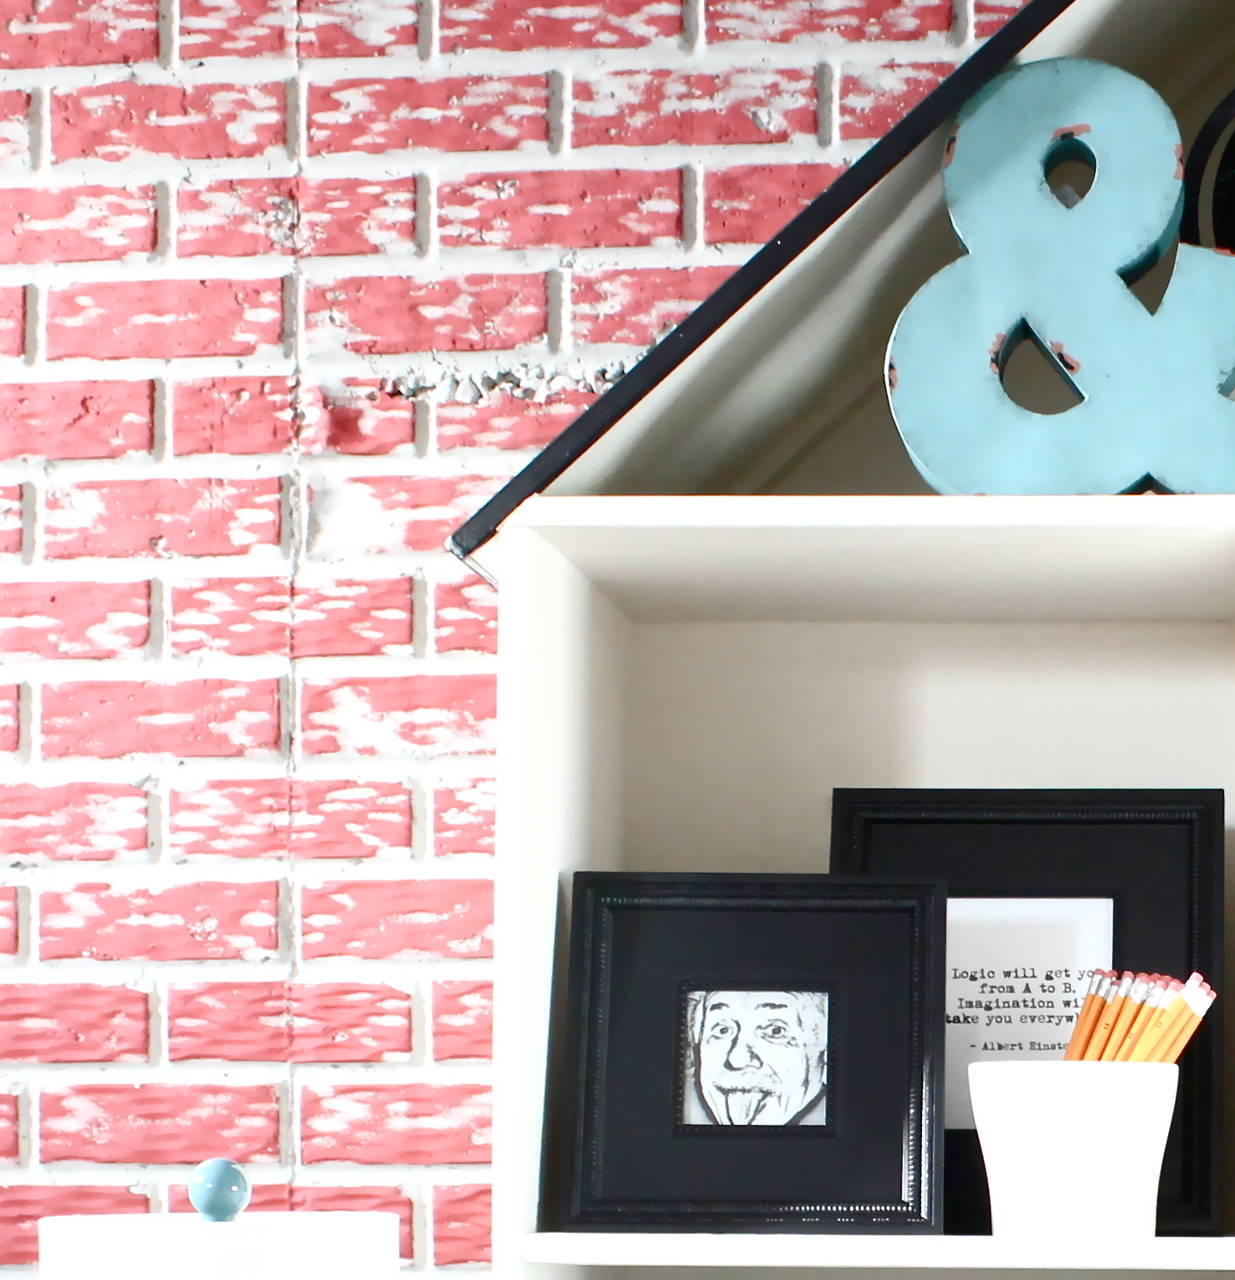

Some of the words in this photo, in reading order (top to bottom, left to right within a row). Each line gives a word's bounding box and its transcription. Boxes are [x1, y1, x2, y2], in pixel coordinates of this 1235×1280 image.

[952, 967, 996, 982] Logic
[1003, 967, 1038, 979] will
[1045, 968, 1071, 981] get
[1077, 969, 1095, 981] yo
[979, 982, 1016, 994] from
[1022, 982, 1033, 994] A
[1039, 983, 1056, 994] to
[1062, 982, 1077, 994] B.
[957, 997, 1055, 1012] Imagination
[1062, 997, 1085, 1009] wi
[945, 1012, 980, 1025] take
[985, 1014, 1013, 1027] you
[1019, 1012, 1079, 1027] everyw
[982, 1041, 1024, 1052] Albert
